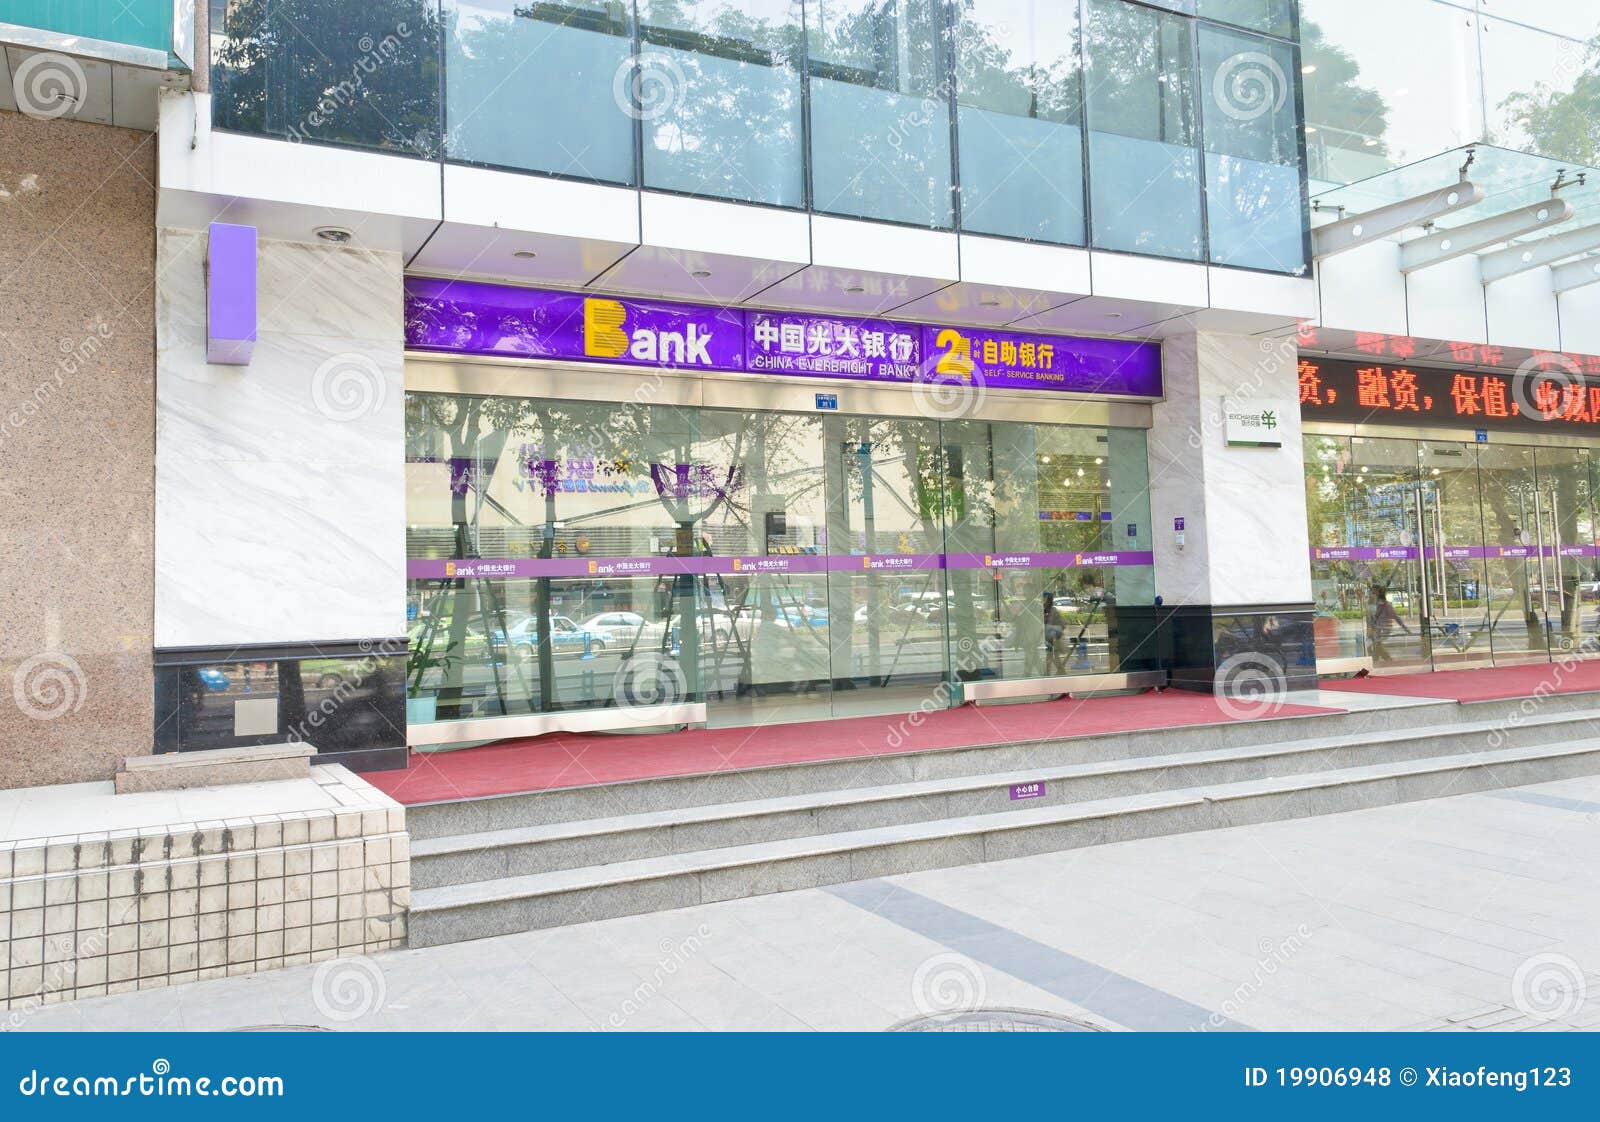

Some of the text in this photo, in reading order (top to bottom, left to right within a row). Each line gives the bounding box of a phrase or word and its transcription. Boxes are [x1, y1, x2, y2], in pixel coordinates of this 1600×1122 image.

[584, 298, 713, 365] Bank
[754, 319, 914, 361] 中国光大银行
[935, 329, 975, 381] 24
[983, 339, 1054, 369] 自助银行
[755, 355, 911, 377] CHINA EVERBRIGHT BANK
[1036, 372, 1065, 382] BANKING
[446, 562, 475, 576] Bank
[477, 564, 516, 572] 中国光大银行
[588, 560, 615, 574] Bank
[733, 559, 757, 571] Bank
[863, 556, 885, 569] Bank
